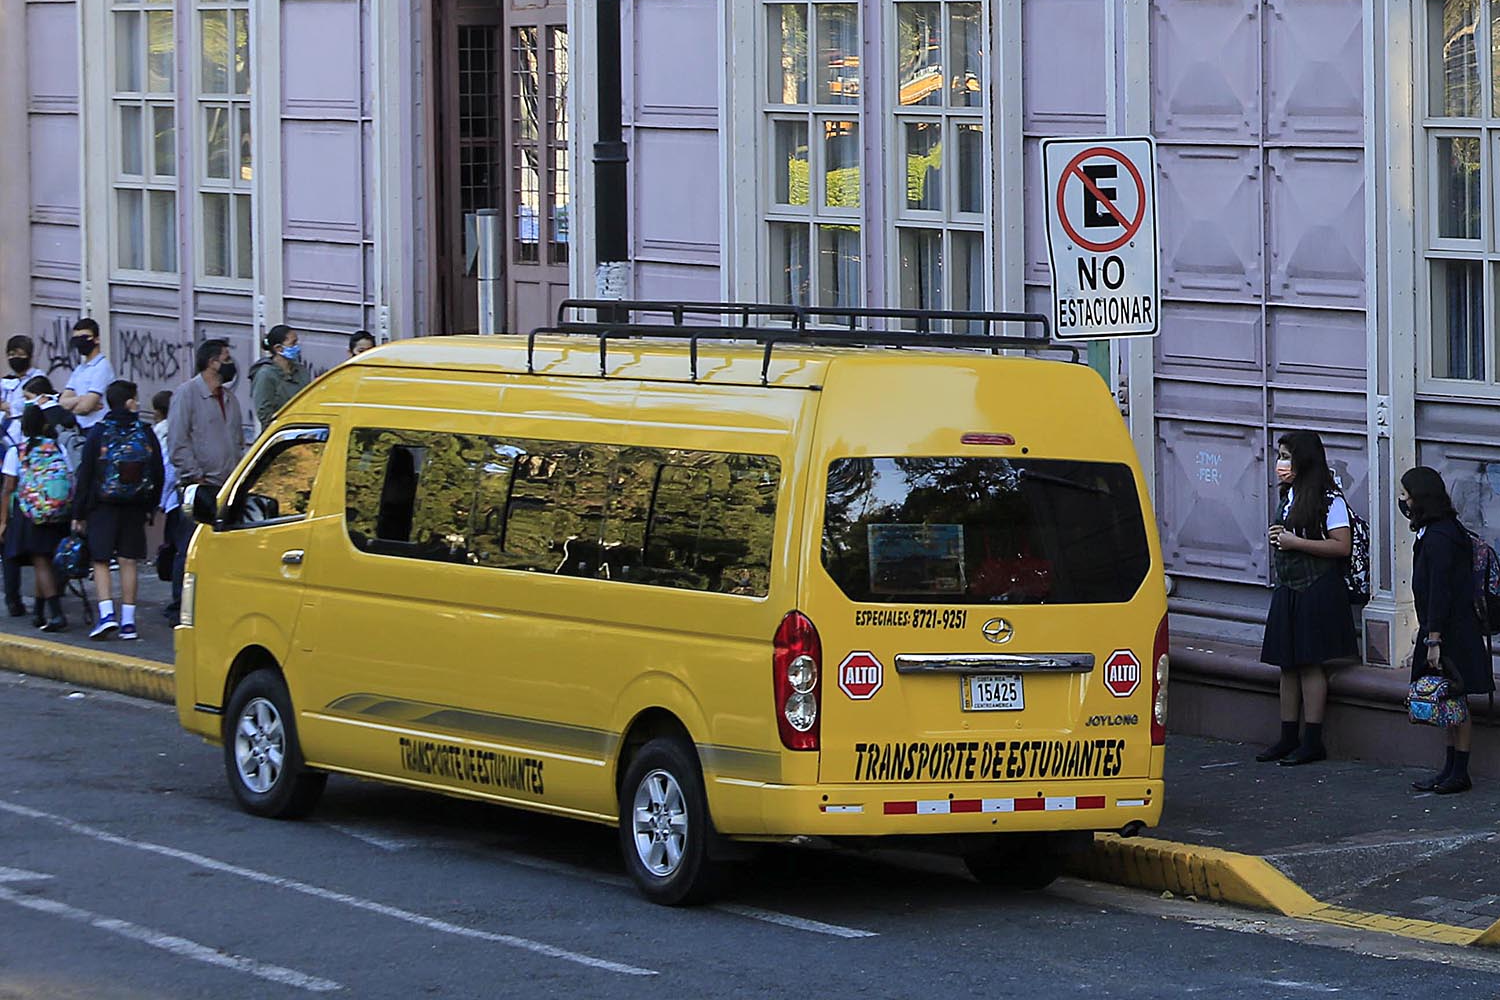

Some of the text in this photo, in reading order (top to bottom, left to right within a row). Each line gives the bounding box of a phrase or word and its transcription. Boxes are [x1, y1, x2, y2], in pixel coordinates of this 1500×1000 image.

[1083, 165, 1120, 227] E
[1077, 256, 1125, 291] NO
[1059, 296, 1153, 328] ESTACIONAR
[855, 609, 967, 629] ESPECIALES: 8721-9251
[845, 666, 878, 685] ALTO
[1110, 665, 1136, 682] ALTO
[977, 682, 1017, 702] 15425
[1085, 714, 1138, 727] JOYLONG
[399, 737, 544, 795] TRANSPORTE DE ESTUDIANTES
[855, 739, 1125, 781] TRANSPORTE DE ESTUDIANTES
